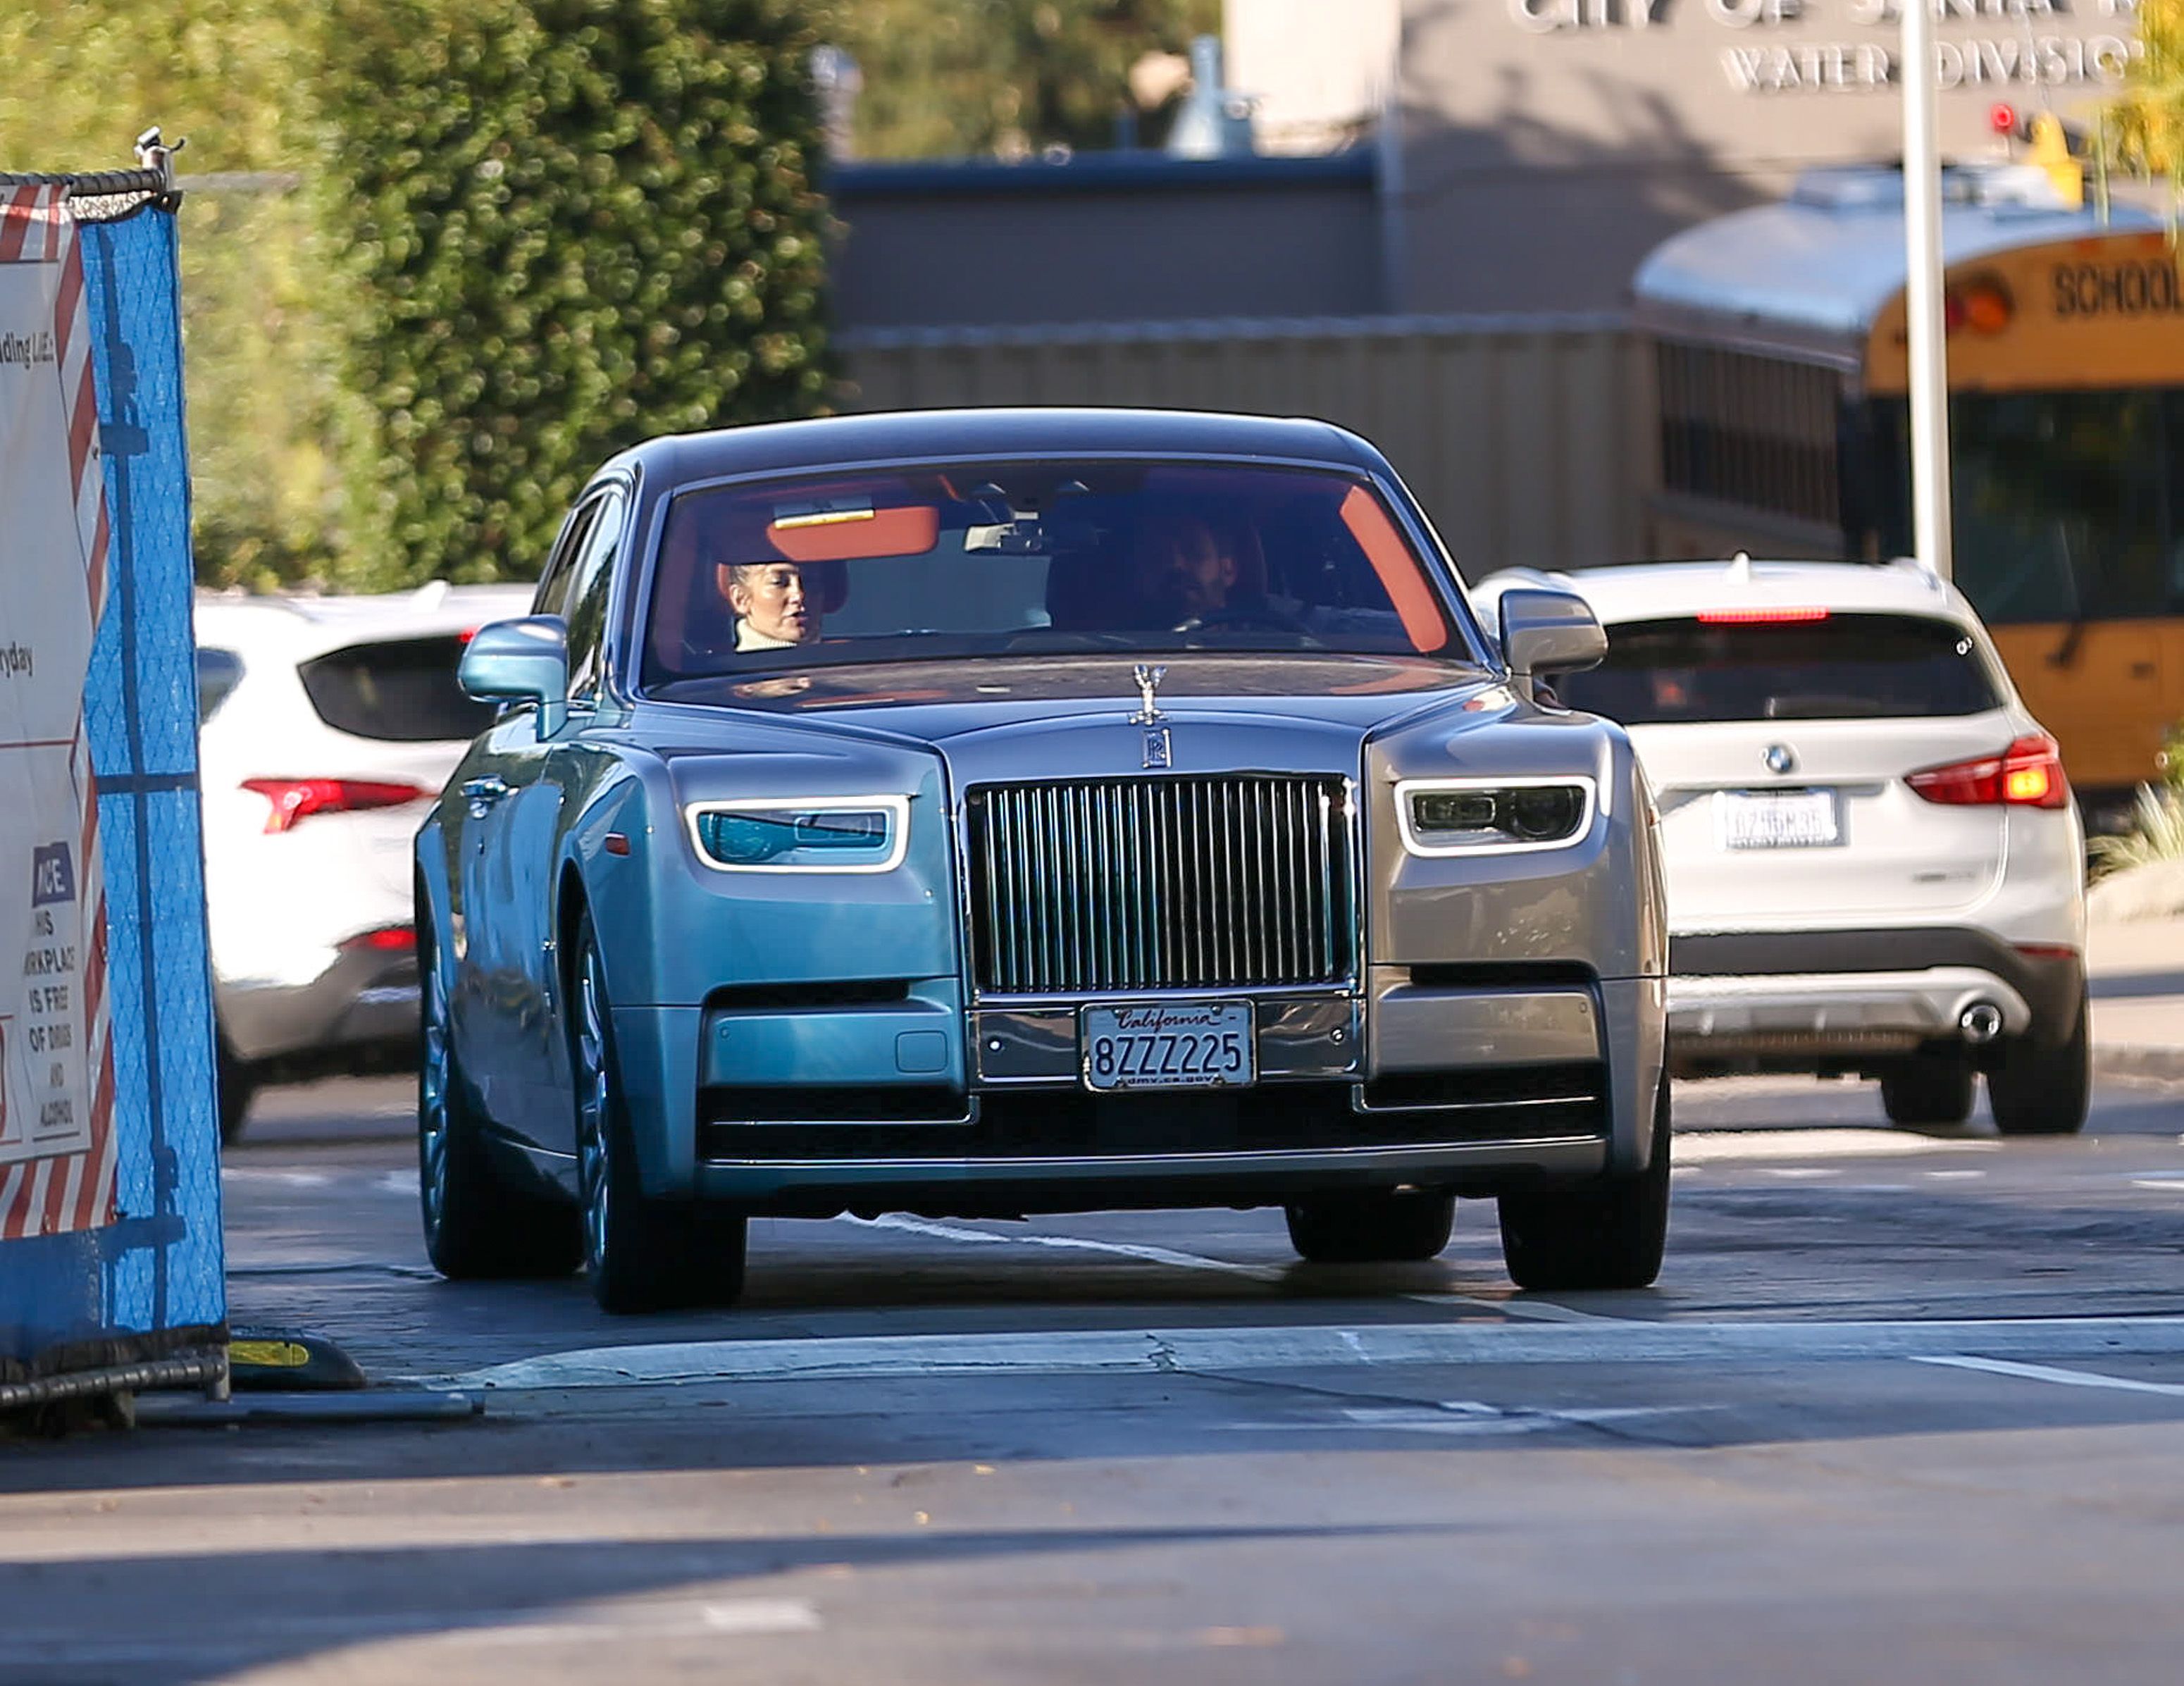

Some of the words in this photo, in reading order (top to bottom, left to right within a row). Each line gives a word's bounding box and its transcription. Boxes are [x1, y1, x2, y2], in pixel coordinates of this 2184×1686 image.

[1719, 43, 1895, 92] WATER
[1932, 34, 2146, 91] DIVISIO
[29, 987, 43, 1014] IS
[1117, 1009, 1222, 1033] California
[29, 1027, 45, 1052] OF
[1096, 1033, 1241, 1075] 8ZZZ225
